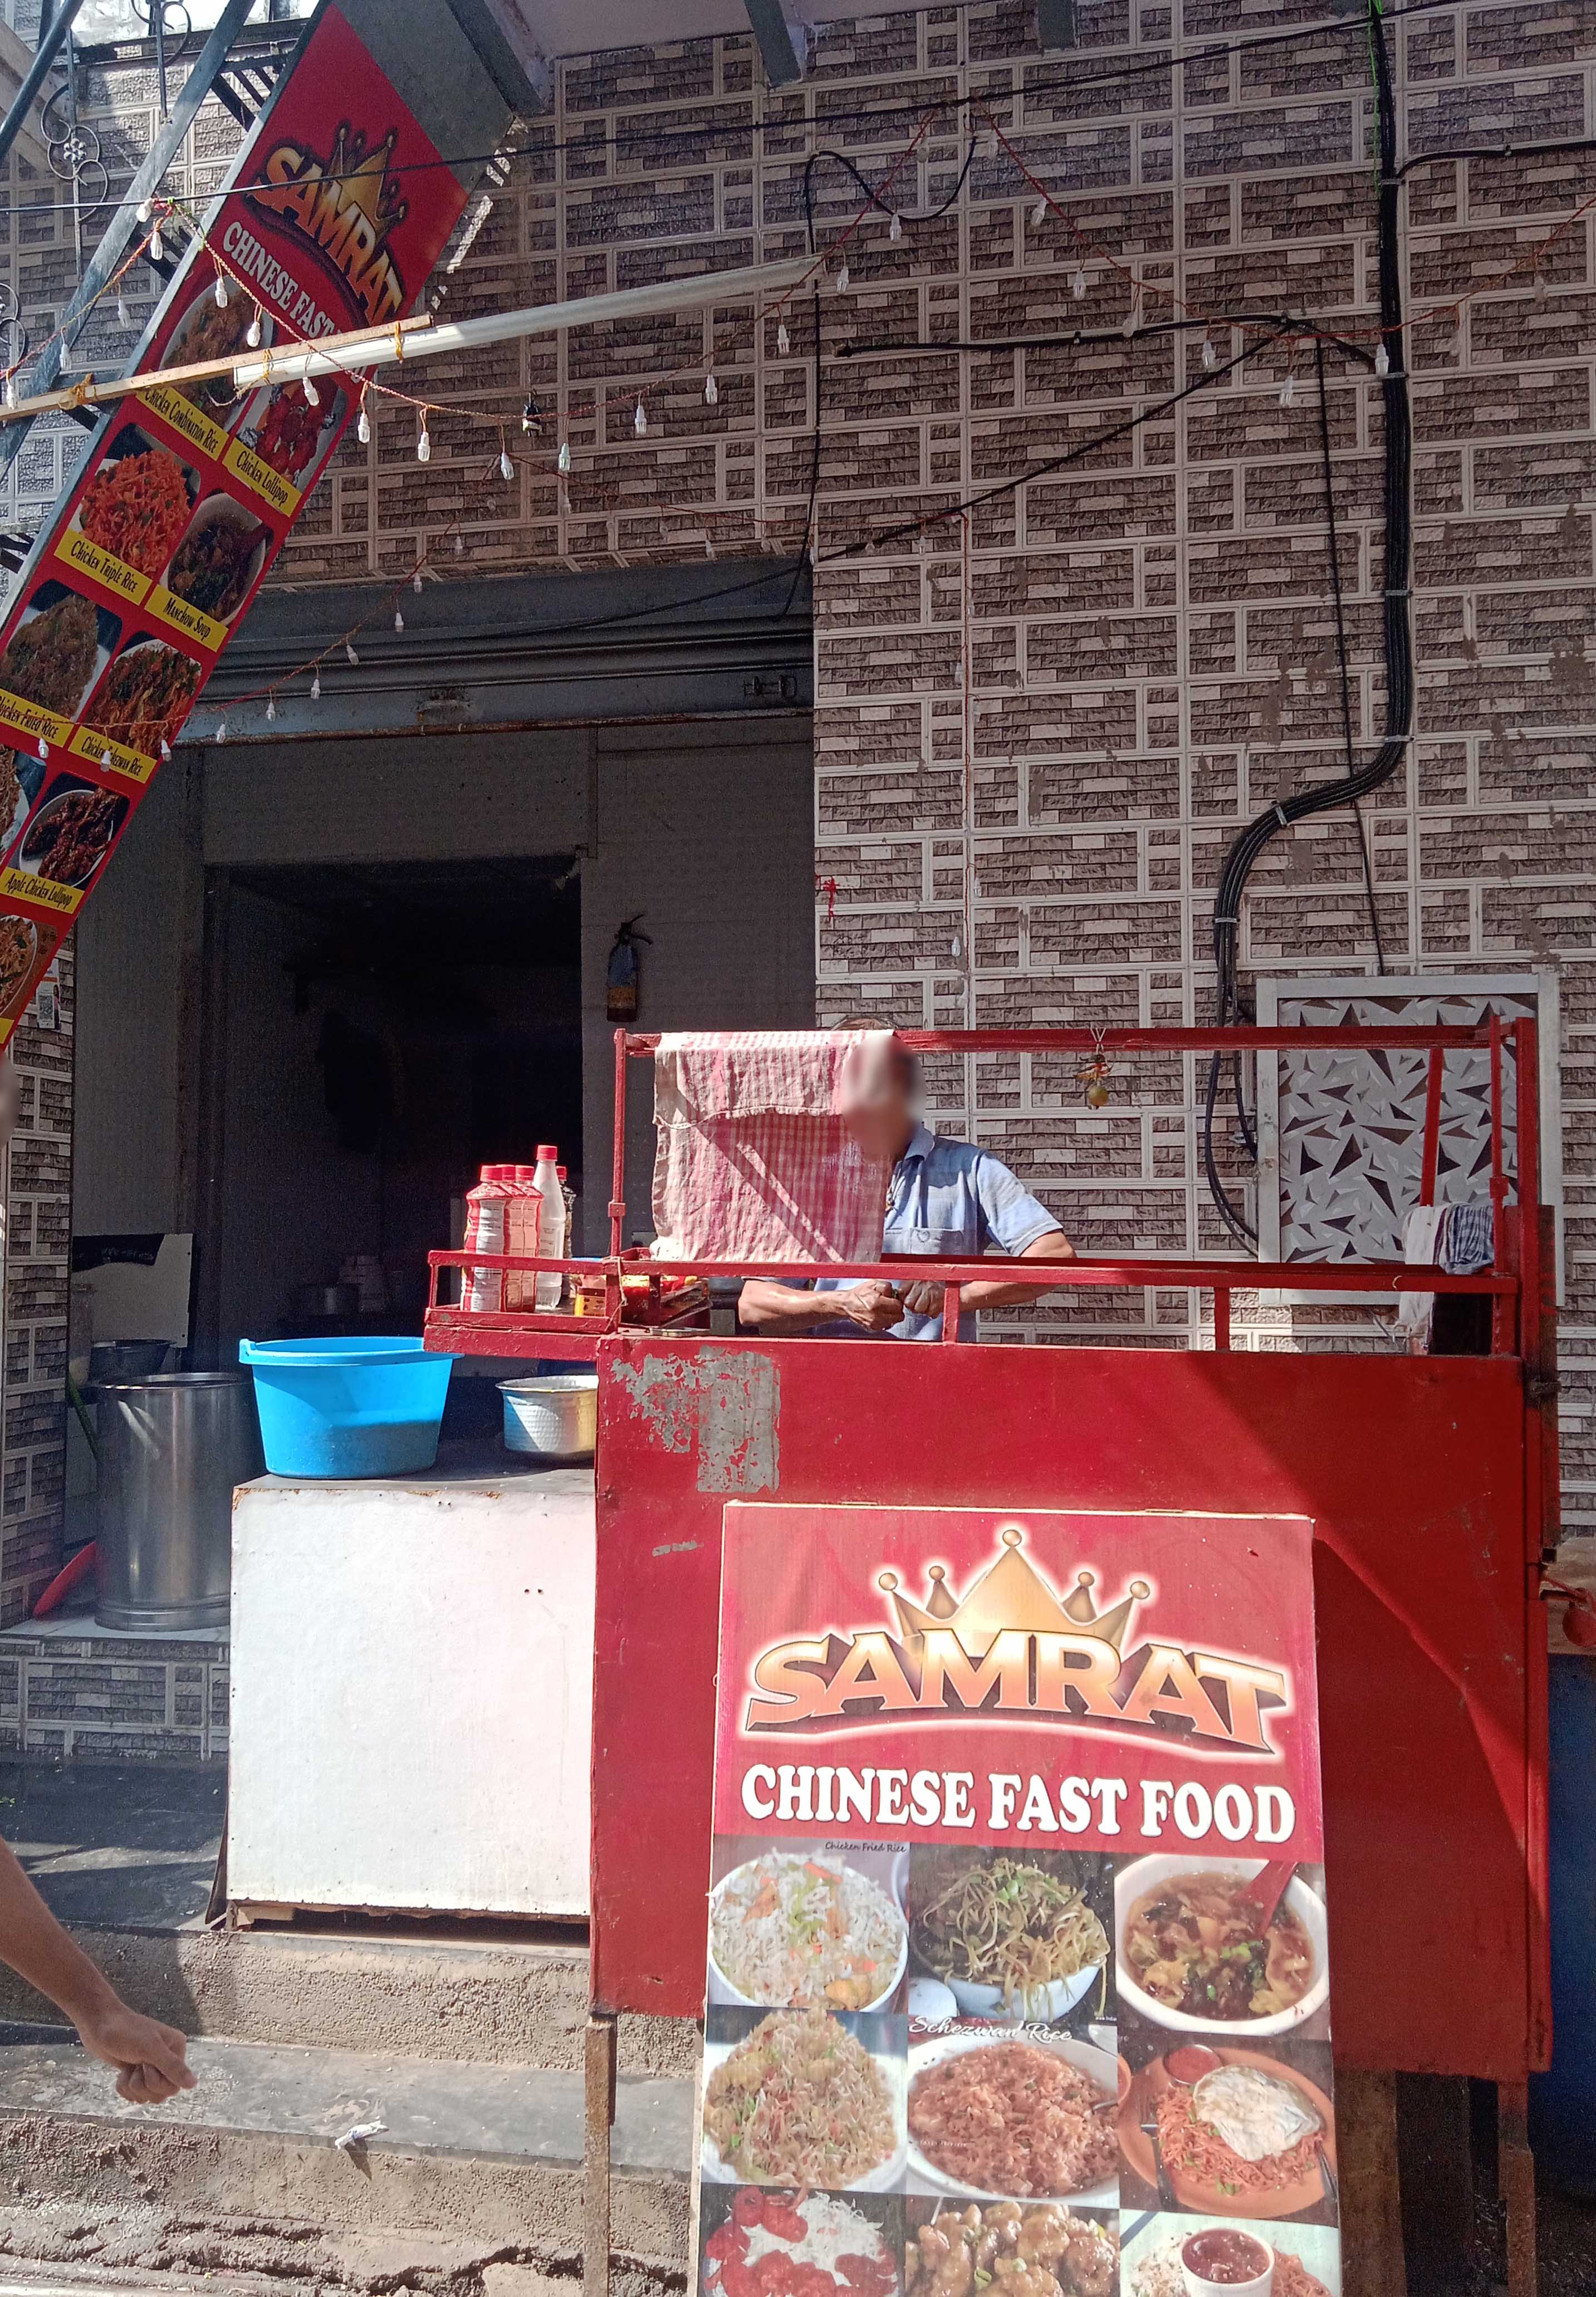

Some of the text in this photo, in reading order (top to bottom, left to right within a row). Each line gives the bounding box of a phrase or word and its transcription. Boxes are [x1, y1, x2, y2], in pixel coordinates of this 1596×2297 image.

[246, 146, 405, 326] SAMRAT
[223, 222, 335, 338] CHINESE FAST
[203, 428, 218, 453] Rice
[237, 450, 288, 507] Chicken Lollipop
[71, 540, 138, 592] Chicken Triple Rice
[193, 616, 211, 641] Soup
[0, 696, 20, 722] hicken
[128, 757, 143, 776] Rice
[5, 873, 27, 894] Apple
[25, 878, 50, 899] Chicken
[746, 1627, 1287, 1754] SAMRAT
[741, 1764, 1297, 1843] CHINESE FAST FOOD
[825, 1841, 907, 1853] Chicken Fried Rice
[908, 2015, 1073, 2044] Schezwan Rice
